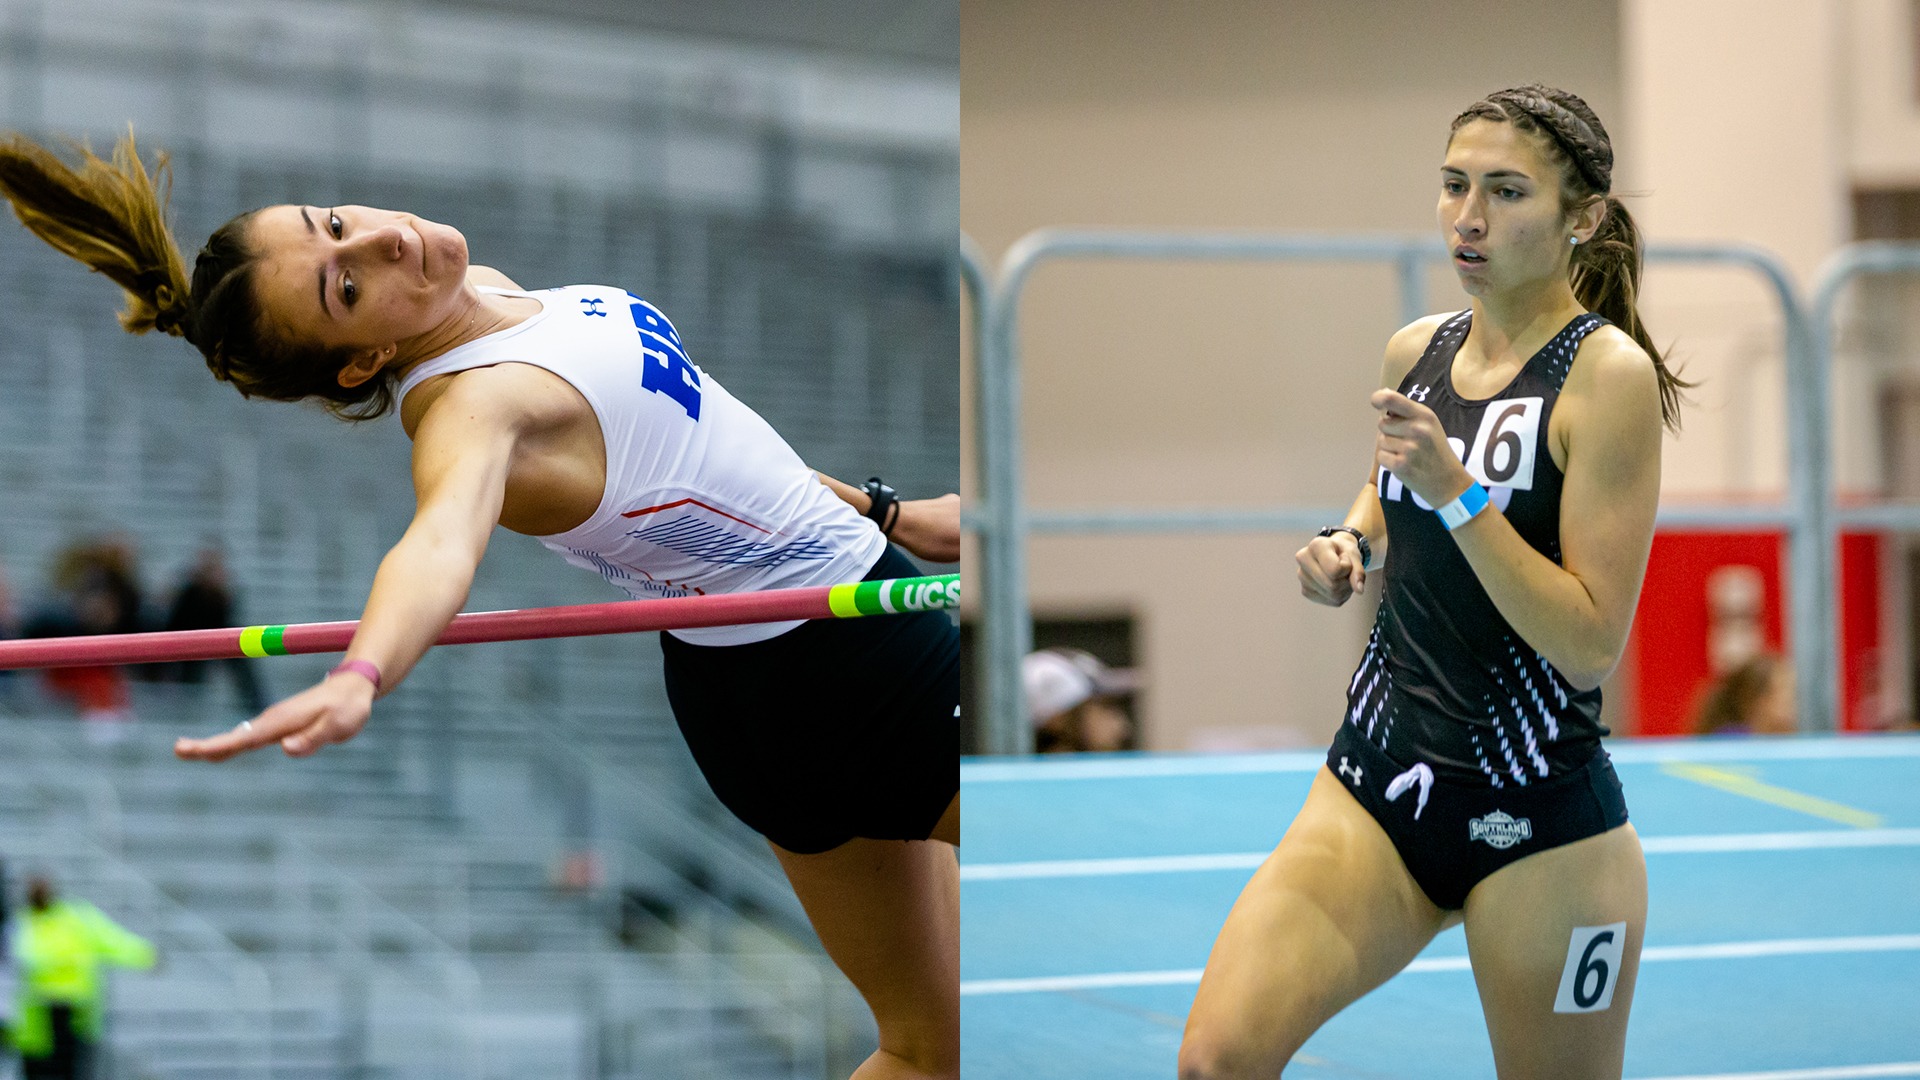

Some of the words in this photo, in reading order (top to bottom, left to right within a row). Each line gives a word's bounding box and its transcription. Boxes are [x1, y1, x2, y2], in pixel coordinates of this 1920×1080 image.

[627, 291, 702, 423] HB
[1483, 403, 1527, 483] 6
[1471, 821, 1529, 837] SOUTHLAND
[1573, 930, 1615, 1009] 6
